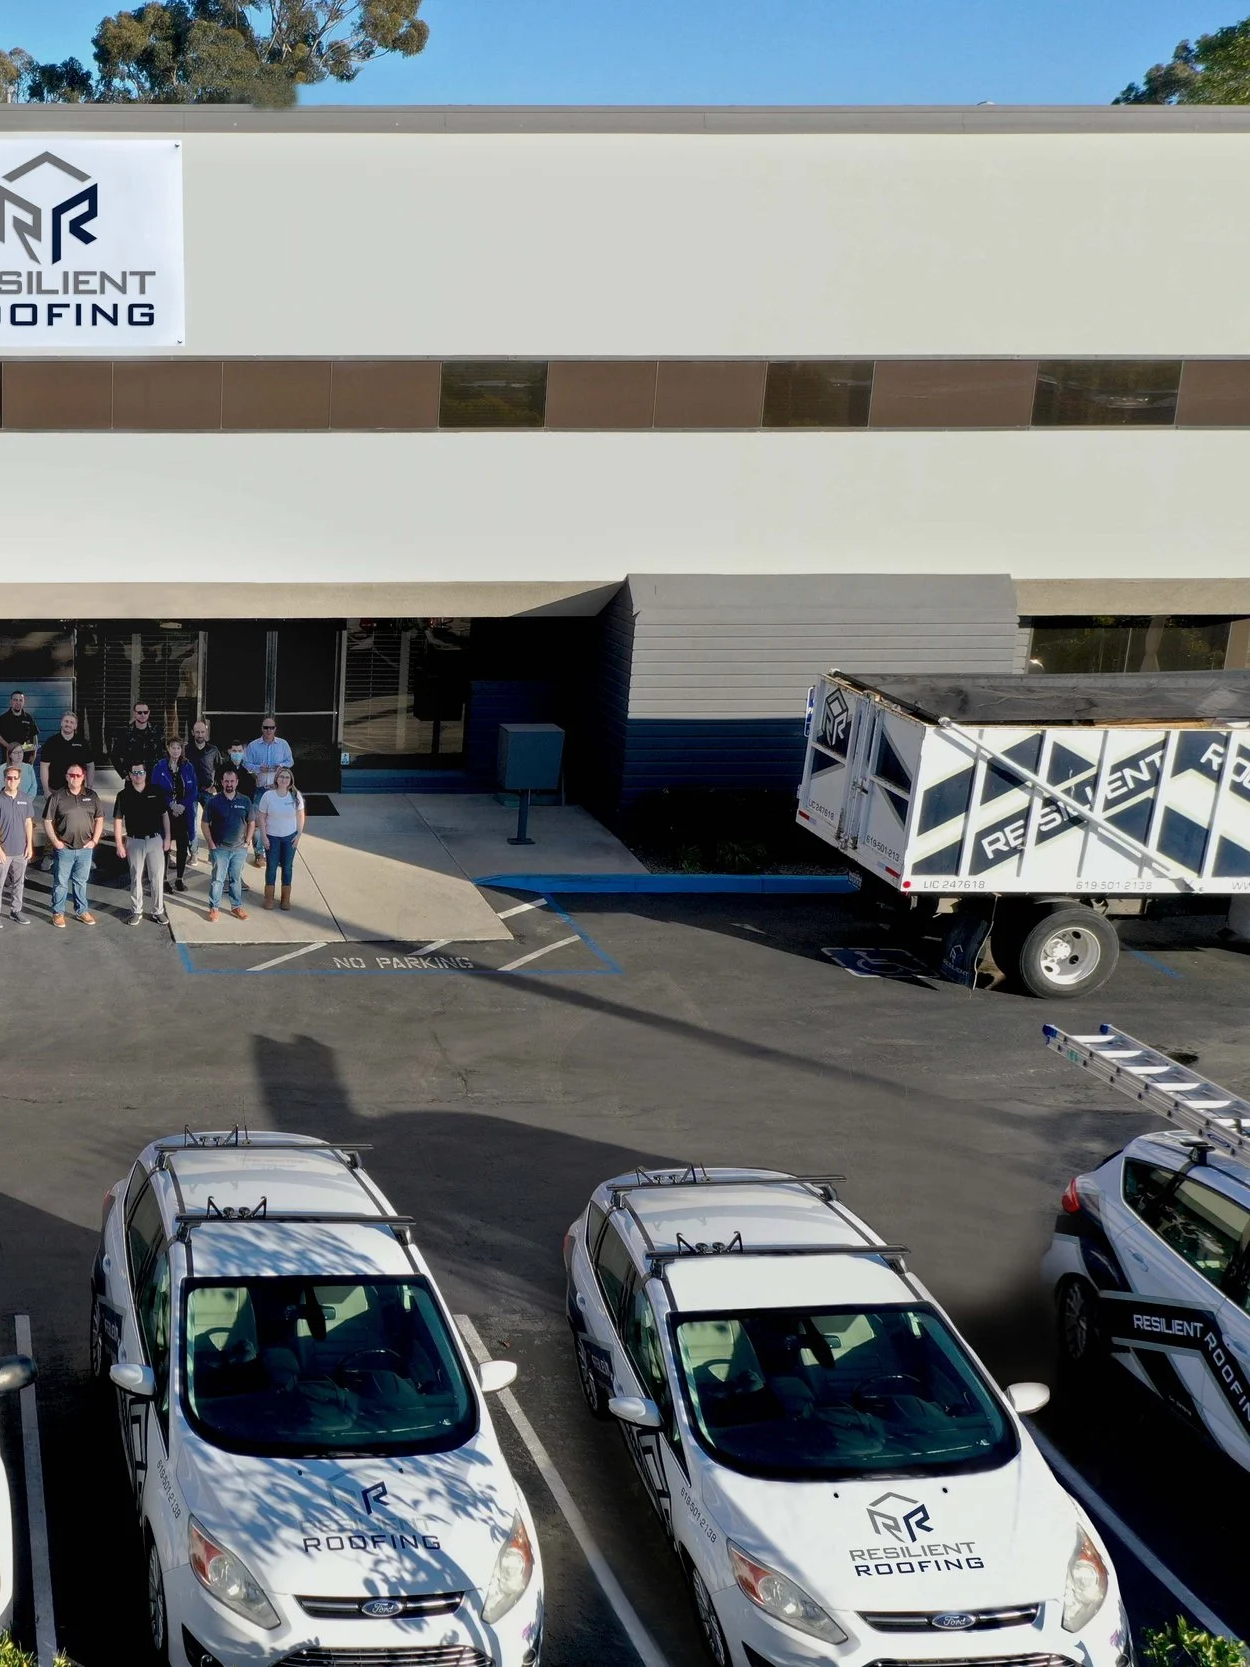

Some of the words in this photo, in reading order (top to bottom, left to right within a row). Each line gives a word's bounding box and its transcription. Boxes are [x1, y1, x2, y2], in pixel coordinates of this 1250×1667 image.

[923, 880, 940, 889] LIC
[941, 880, 986, 890] 247618
[332, 957, 367, 968] NO
[376, 956, 475, 969] PARKING
[1133, 1314, 1204, 1338] RESILIENT
[303, 1534, 441, 1552] ROOFING
[849, 1541, 977, 1562] RESILIENT
[854, 1557, 985, 1576] ROOFING
[372, 1602, 395, 1614] Ford
[943, 1615, 967, 1626] Ford
